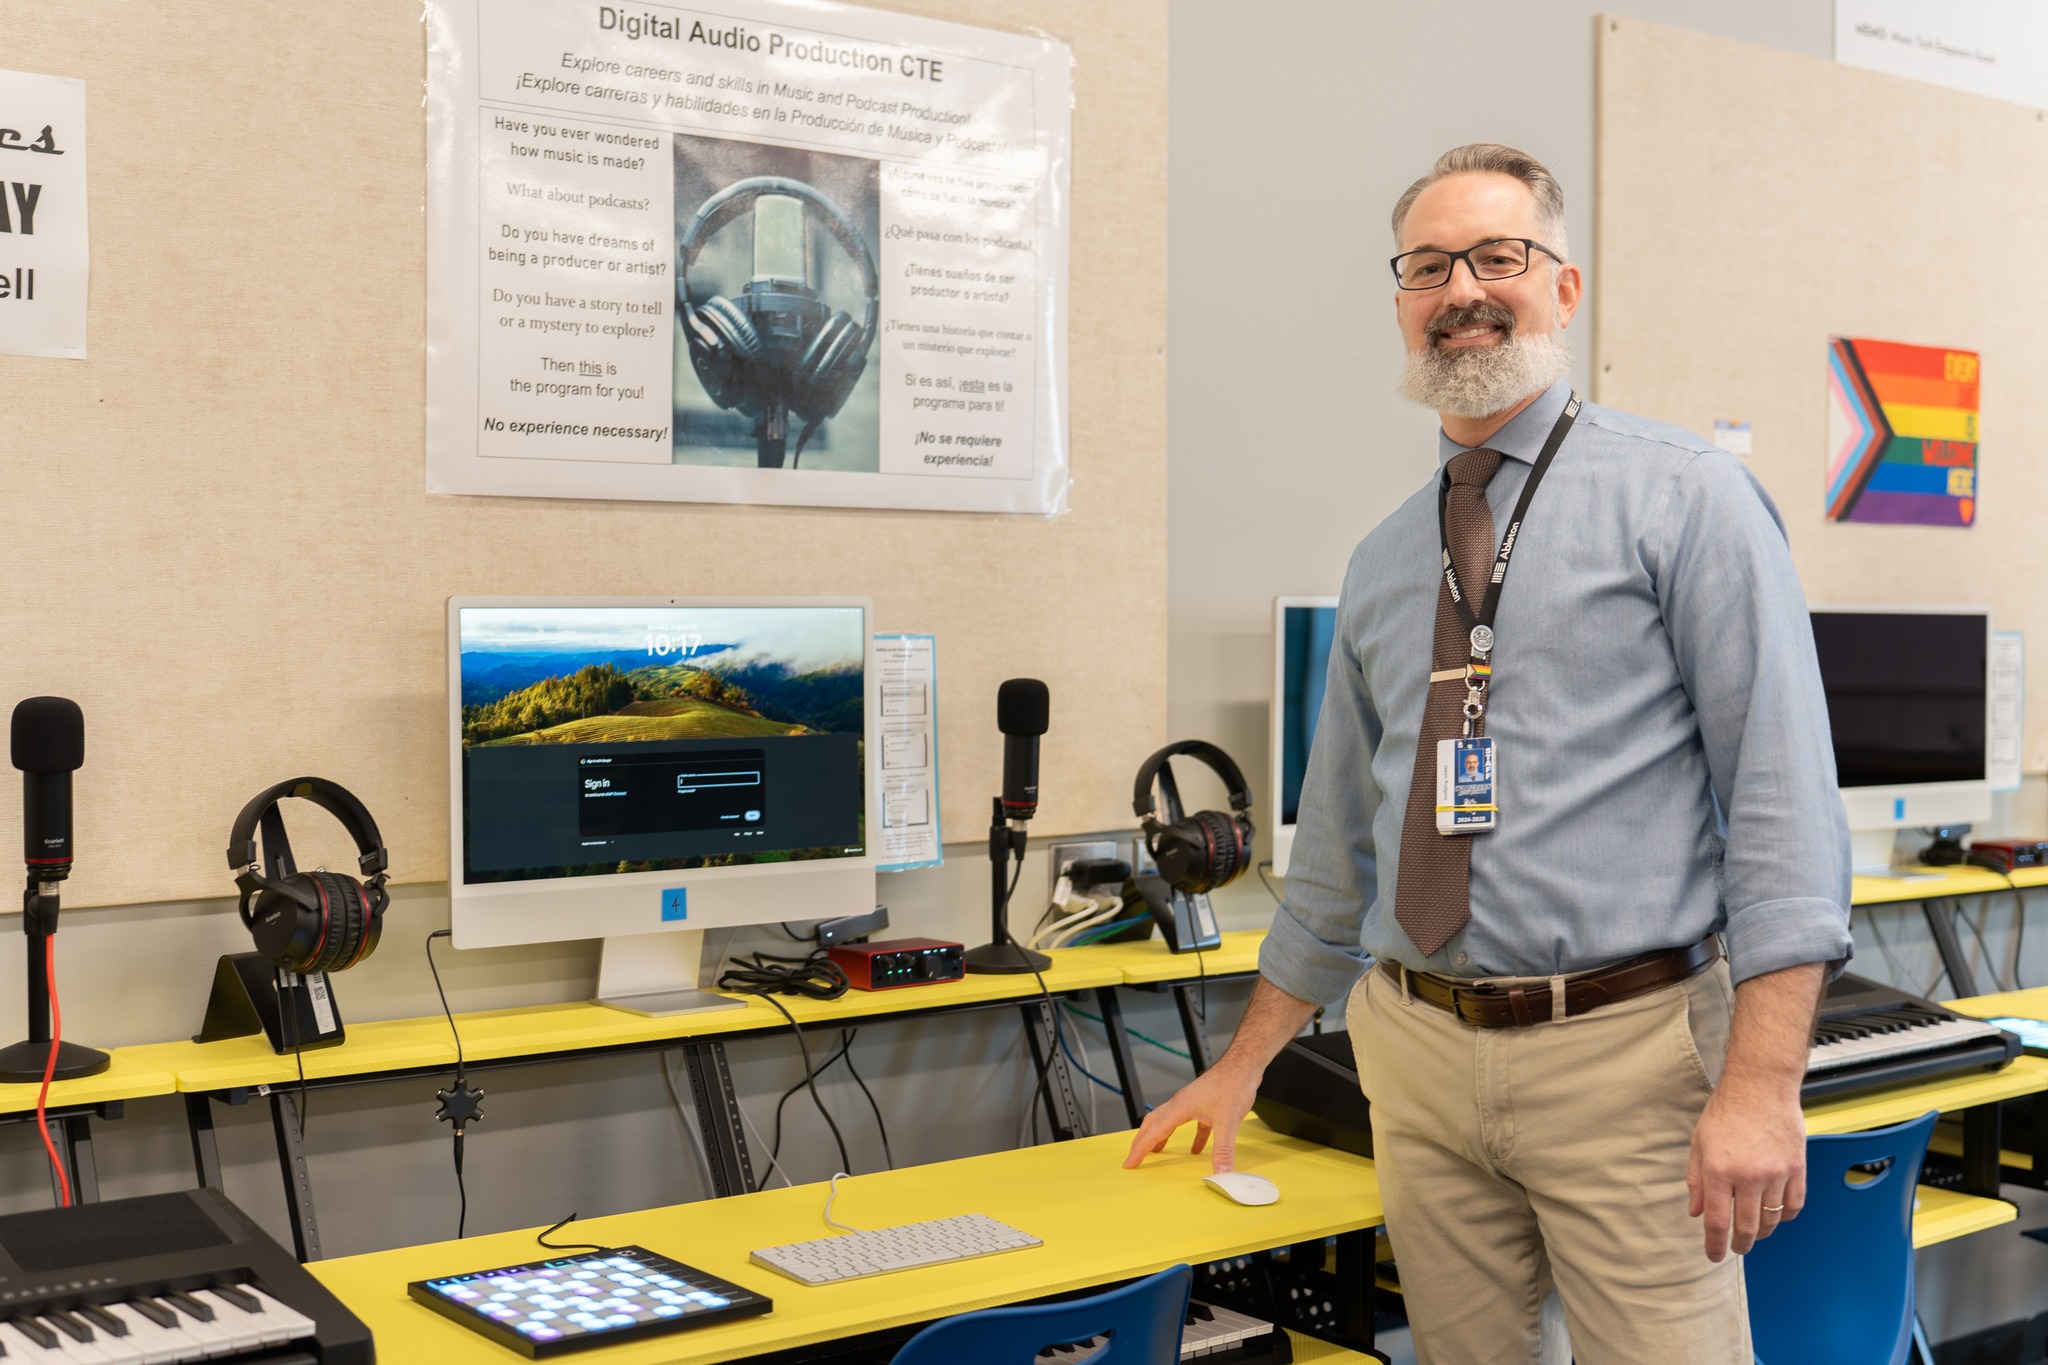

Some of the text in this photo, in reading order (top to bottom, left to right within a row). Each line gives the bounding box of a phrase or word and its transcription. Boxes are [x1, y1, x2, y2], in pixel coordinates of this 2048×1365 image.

[599, 7, 943, 83] Digital Audio Production CTE
[561, 52, 972, 127] Explore careers and skills in Music and Podcast Production!
[516, 72, 580, 96] ¡Explore
[585, 84, 648, 105] carreras
[651, 93, 661, 109] y
[666, 93, 748, 119] habilidades
[752, 107, 770, 121] en
[774, 106, 787, 122] la
[790, 109, 864, 135] Producción
[868, 121, 885, 137] de
[887, 123, 932, 144] Música
[935, 132, 944, 149] y
[494, 116, 659, 150] Have you ever wondered
[511, 142, 645, 171] how music is made?
[506, 182, 650, 211] What about podcasts?
[501, 224, 655, 252] Do you have dreams of
[884, 224, 914, 241] ¿Qué
[916, 230, 940, 242] pasa
[943, 232, 963, 243] con
[965, 232, 980, 245] los
[489, 247, 666, 276] being a producer or artist?
[904, 263, 1015, 285] ¿Tienes sueños de ser
[493, 288, 662, 315] Do you have a story to tell
[911, 285, 1009, 303] productor o artista?
[500, 315, 655, 339] or a mystery to explore?
[885, 319, 1032, 342] ¿Tienes una historia que contar o
[902, 340, 1016, 359] un misterio que explorar?
[541, 357, 617, 376] Then this is
[510, 379, 645, 401] the program for you!
[919, 377, 932, 388] es
[988, 382, 1000, 392] es
[1003, 381, 1013, 392] la
[913, 396, 1004, 412] programa para ti!
[484, 417, 668, 442] No experience necessary!
[914, 431, 1002, 447] ¡No se requiere
[923, 453, 993, 467] experiencia!
[1499, 522, 1520, 560] Ableton
[1445, 570, 1461, 602] Ableton
[643, 633, 702, 656] 10:17
[585, 778, 610, 790] Sign in
